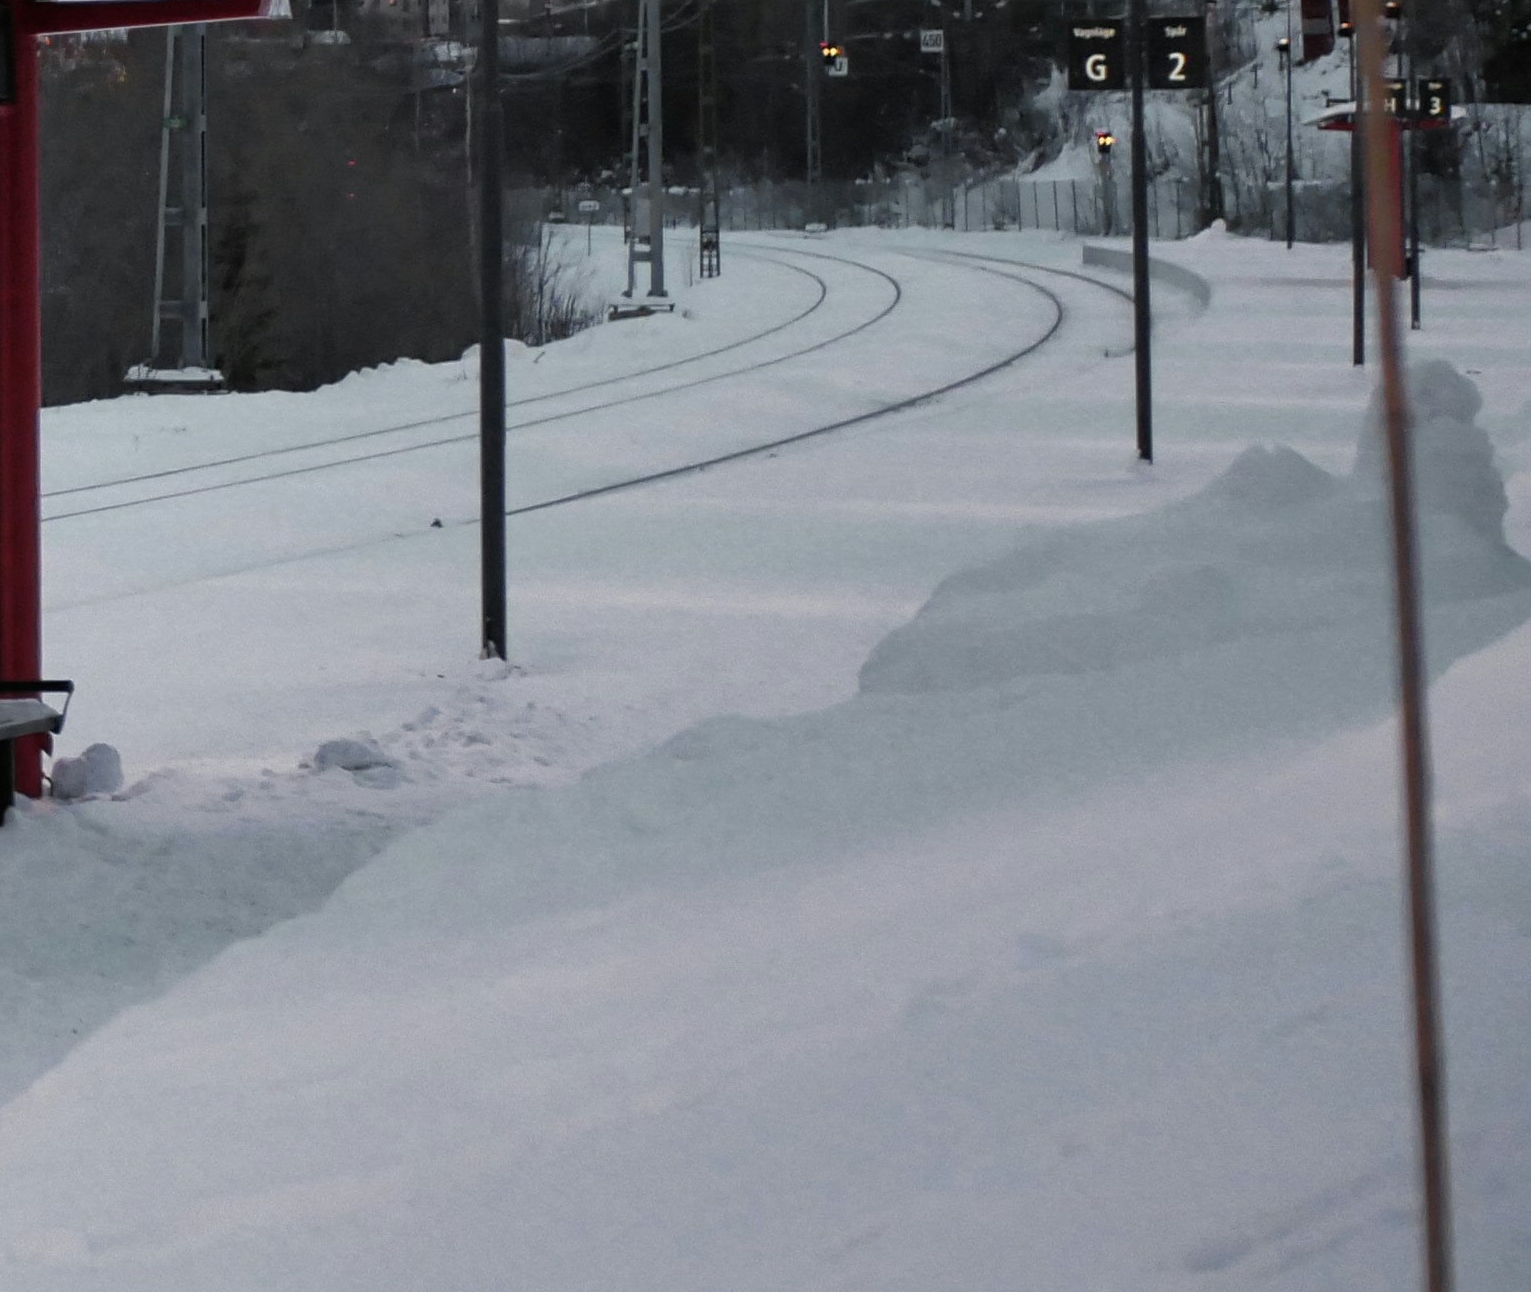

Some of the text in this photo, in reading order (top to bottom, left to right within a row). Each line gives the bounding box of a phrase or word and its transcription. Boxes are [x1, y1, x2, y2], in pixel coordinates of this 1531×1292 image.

[1085, 53, 1108, 81] G
[1168, 52, 1187, 81] 2
[1429, 96, 1441, 115] 3
